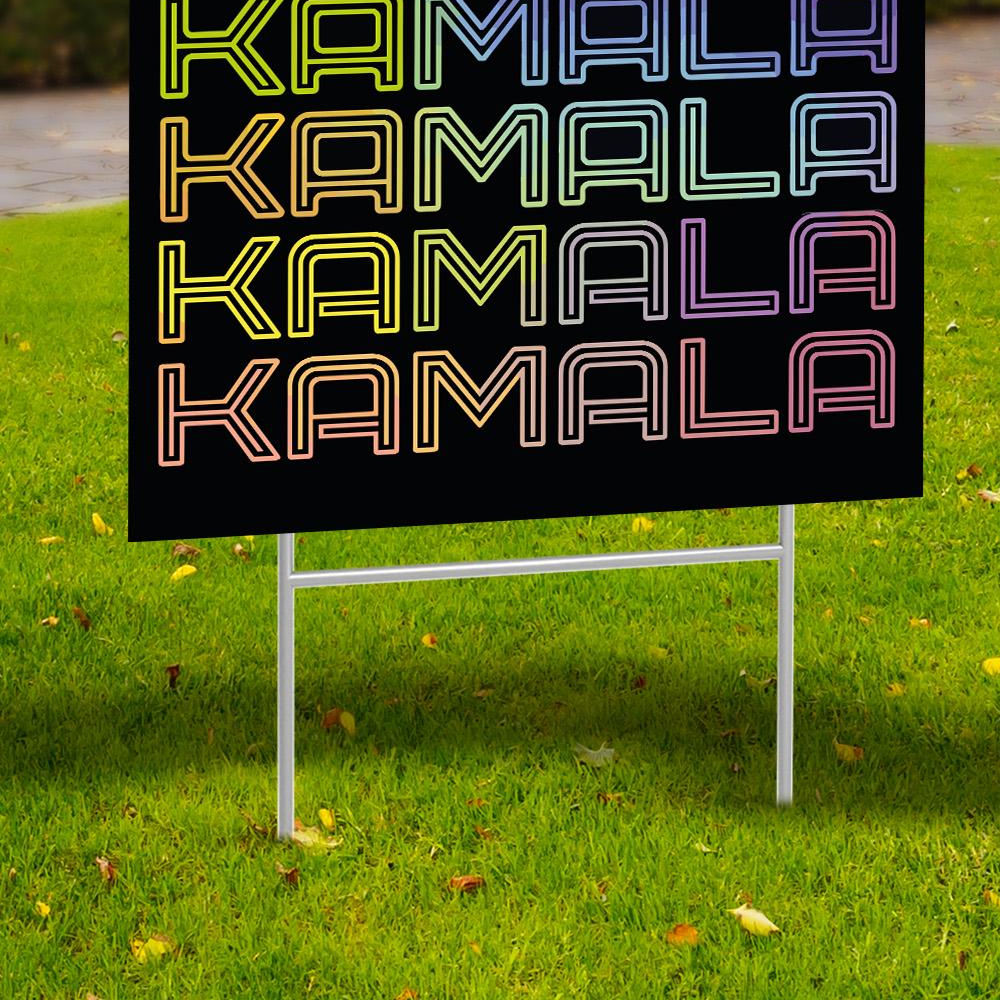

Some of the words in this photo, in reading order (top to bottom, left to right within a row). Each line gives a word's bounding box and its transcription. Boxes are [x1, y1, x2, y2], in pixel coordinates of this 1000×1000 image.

[160, 91, 897, 223] KAMALA
[158, 210, 896, 344] KAMALA
[158, 329, 895, 467] KAMALA
